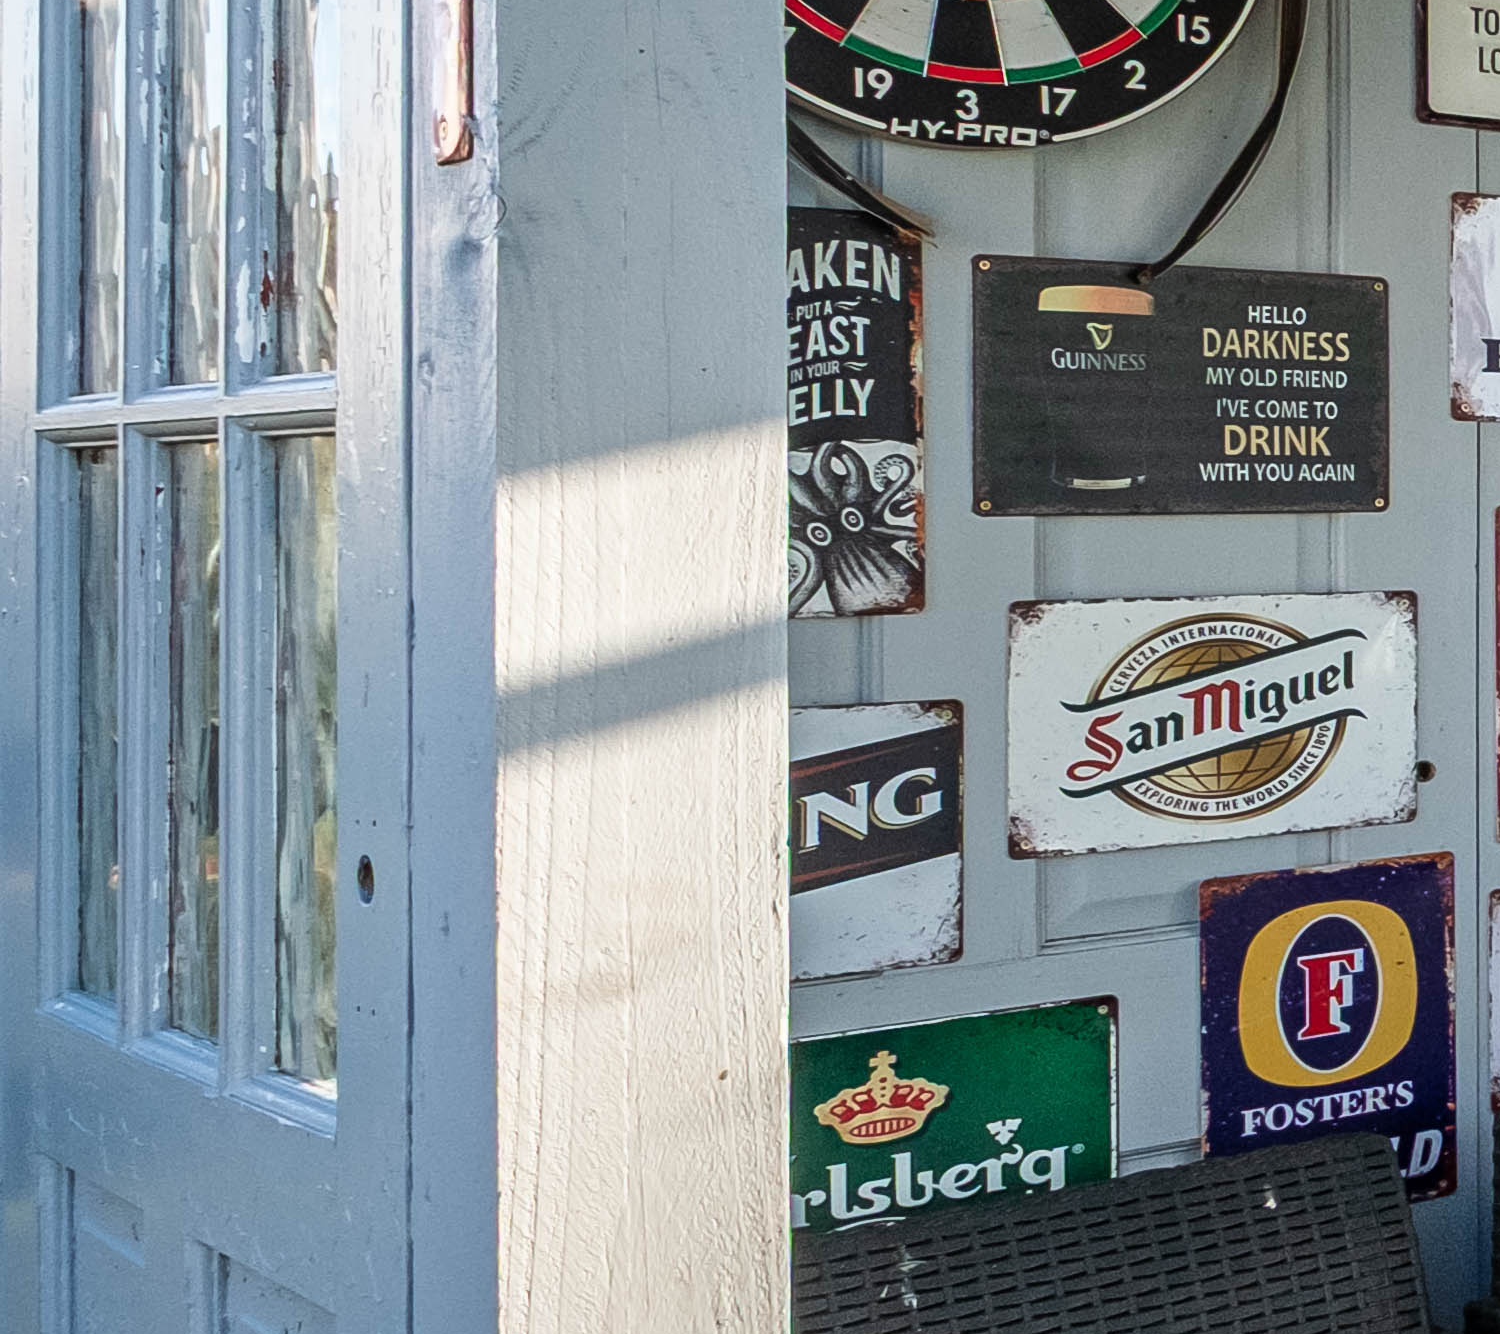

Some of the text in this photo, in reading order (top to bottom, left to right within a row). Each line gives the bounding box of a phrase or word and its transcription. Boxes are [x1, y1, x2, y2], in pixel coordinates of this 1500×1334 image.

[1177, 14, 1210, 45] 15
[854, 68, 893, 100] 19
[1125, 59, 1147, 90] 2
[956, 89, 979, 120] 3
[1041, 86, 1076, 116] 17
[891, 118, 1036, 146] HY-PRO
[796, 300, 832, 322] PUT A
[1248, 305, 1306, 325] HELLO
[1051, 348, 1147, 371] GUINNESS
[1202, 327, 1350, 362] DARKNESS
[790, 360, 840, 383] IN YOUR
[1205, 367, 1348, 388] MY OLD FRIEND
[1216, 398, 1338, 419] I'VE COME TO
[1223, 425, 1331, 457] DRINK
[1199, 463, 1355, 481] WITH YOU AGAIN
[1110, 625, 1282, 693] CERVEZA INTERNACIONAL
[1240, 1081, 1413, 1137] FOSTER'S
